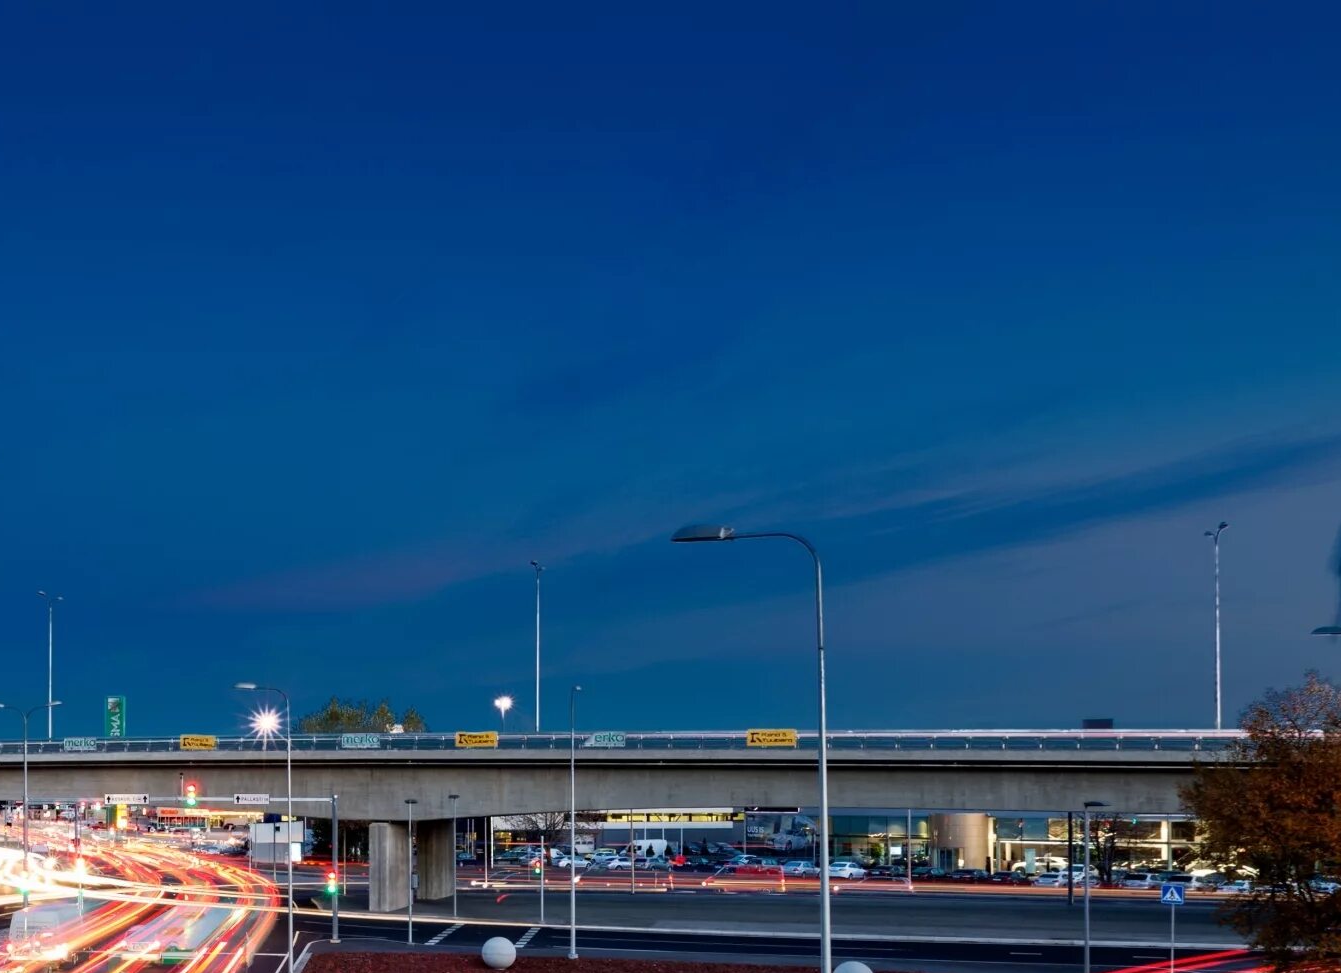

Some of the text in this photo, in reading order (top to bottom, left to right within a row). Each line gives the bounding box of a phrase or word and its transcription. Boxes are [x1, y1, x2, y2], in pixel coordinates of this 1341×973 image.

[64, 736, 97, 747] merko
[342, 733, 380, 744] merko
[594, 732, 625, 743] erko
